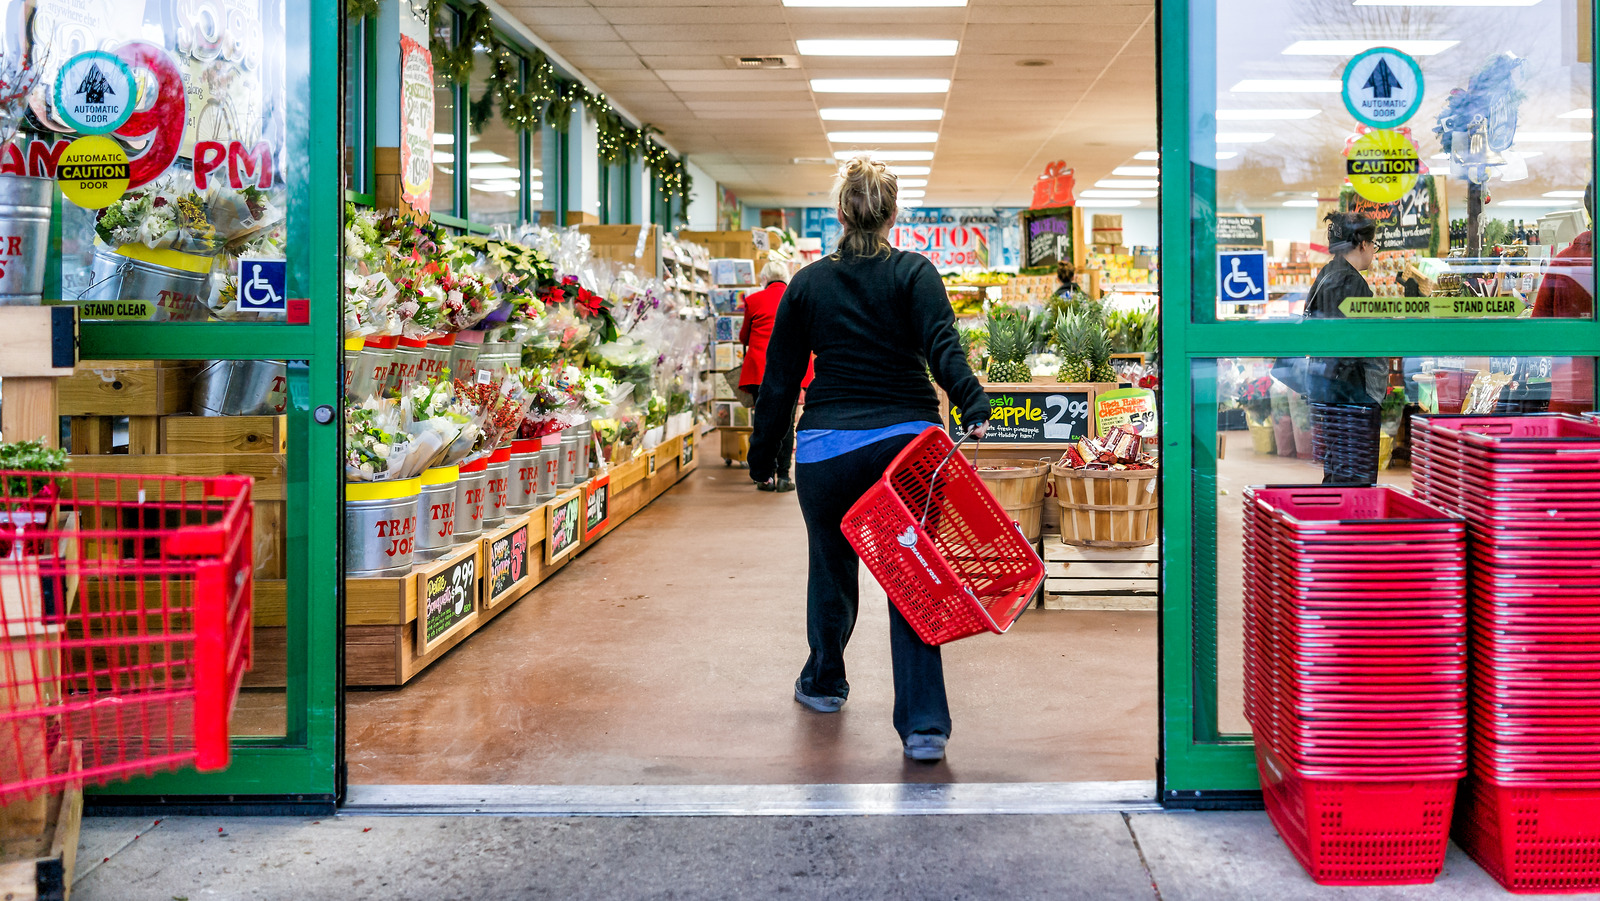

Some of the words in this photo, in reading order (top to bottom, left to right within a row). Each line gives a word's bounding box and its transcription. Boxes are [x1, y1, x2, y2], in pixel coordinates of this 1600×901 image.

[1362, 100, 1407, 108] AUTOMATIC
[74, 105, 119, 114] AUTOMATIC
[1373, 109, 1396, 117] DOOR
[85, 114, 108, 123] DOOR
[1356, 148, 1412, 157] AUTOMATIC
[66, 154, 122, 163] AUTOMATIC
[194, 140, 272, 191] PM
[1351, 160, 1416, 173] CAUTION
[62, 165, 126, 179] CAUTION
[1369, 176, 1398, 184] DOOR
[80, 181, 108, 190] DOOR
[84, 303, 114, 316] STAND
[117, 303, 147, 316] CLEAR
[1350, 301, 1402, 313] AUTOMATIC
[1405, 301, 1430, 313] DOOR
[1453, 301, 1483, 313] STAND
[1486, 301, 1515, 313] CLEAR
[989, 394, 1014, 407] esh
[950, 398, 1042, 427] Papple
[1098, 405, 1148, 419] CHESTNUTS
